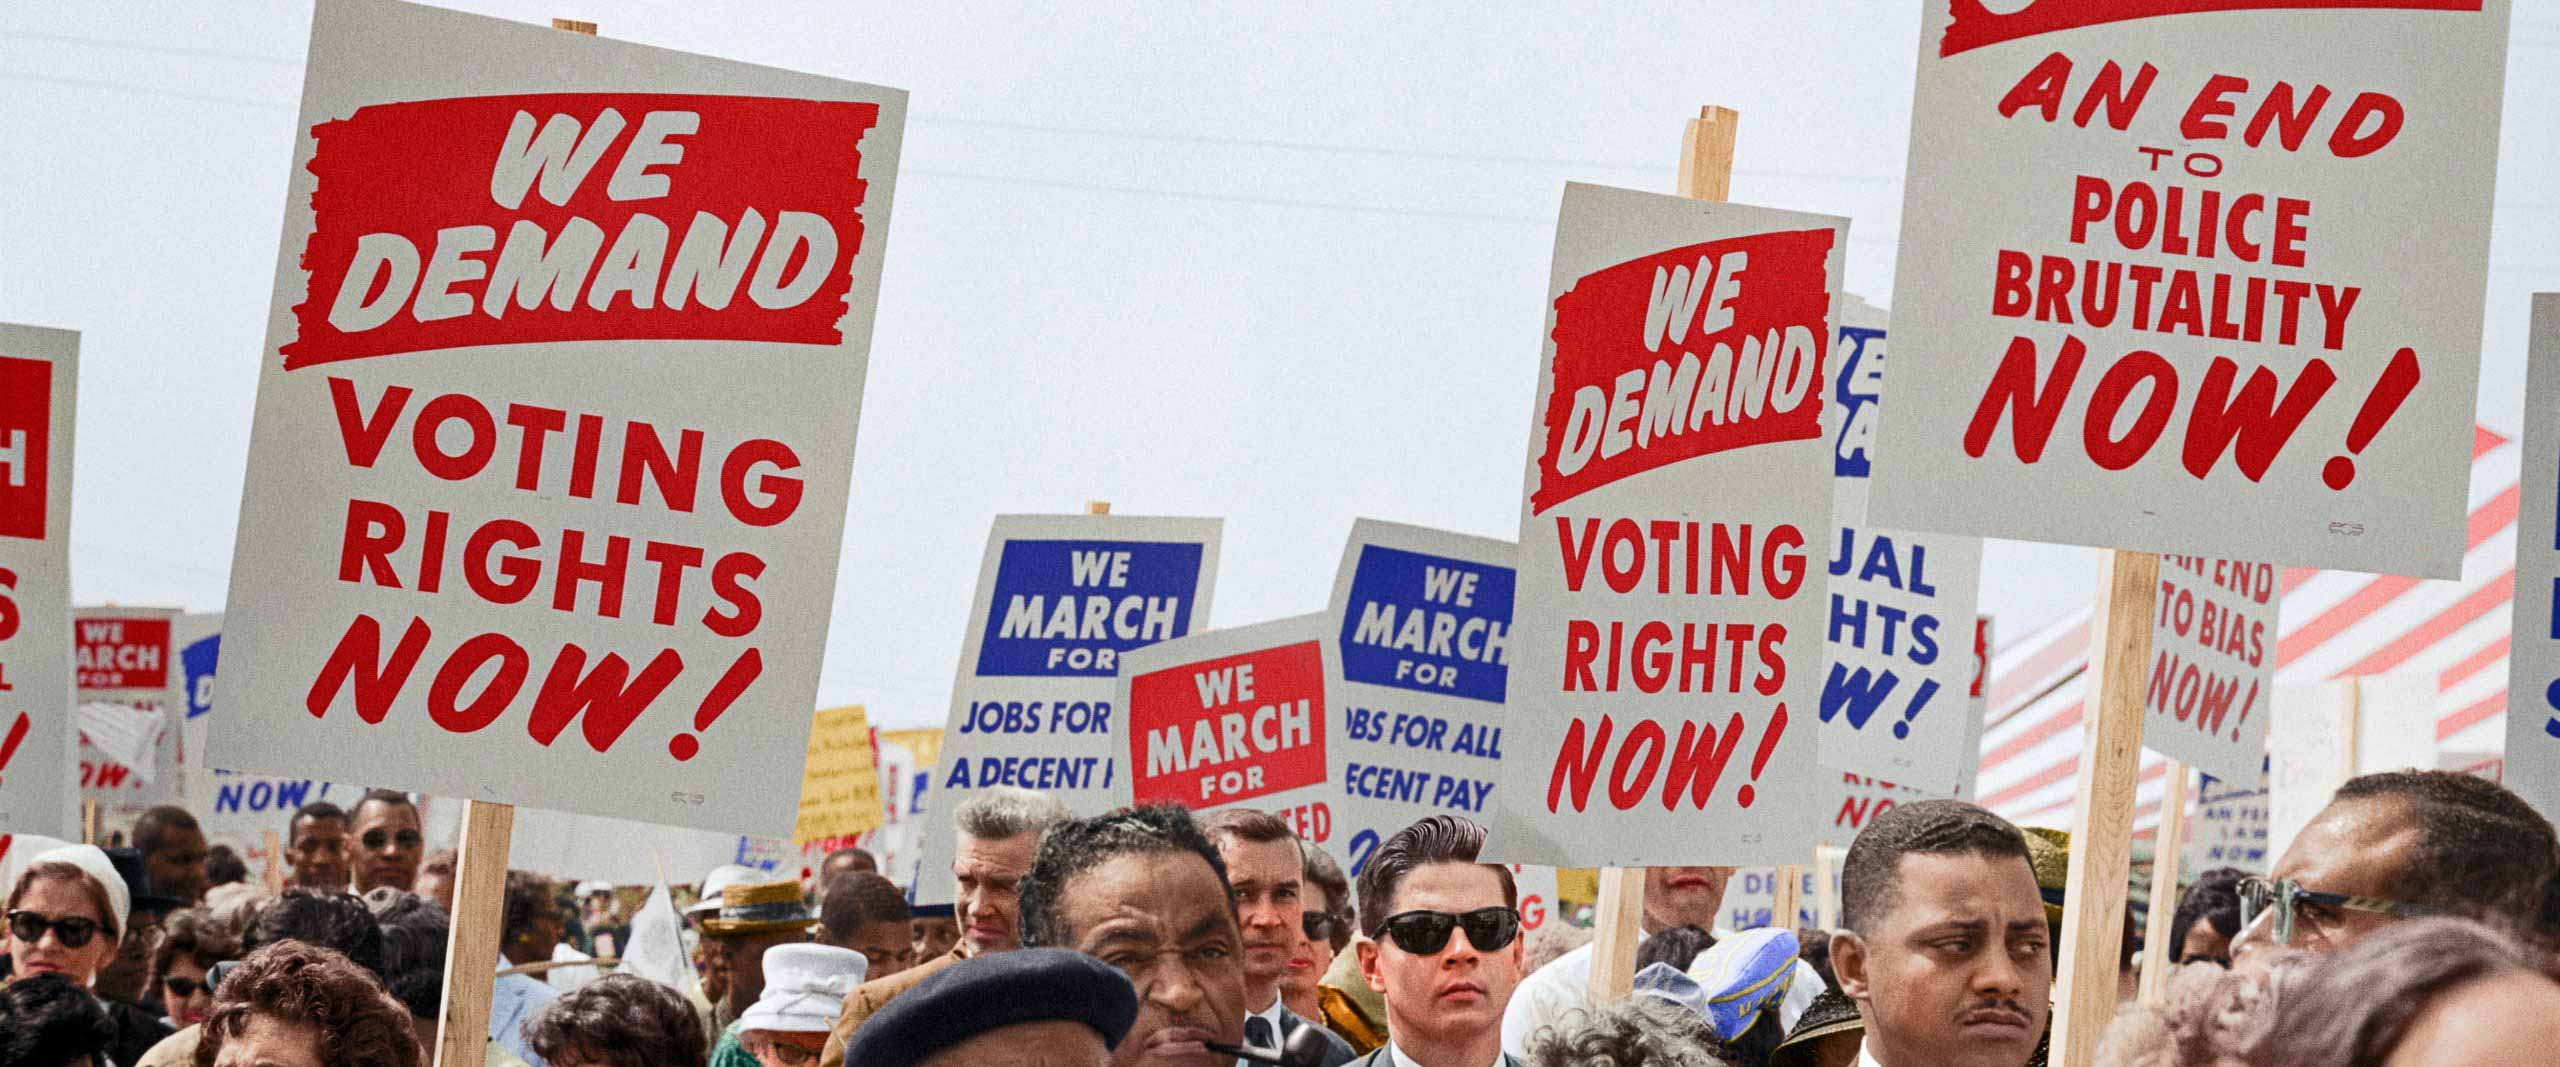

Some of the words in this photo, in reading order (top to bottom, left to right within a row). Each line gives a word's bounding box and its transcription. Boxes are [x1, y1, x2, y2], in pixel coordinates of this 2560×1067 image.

[1998, 51, 2159, 131] AN
[2179, 73, 2404, 158] END
[490, 107, 700, 210] WE
[2138, 146, 2223, 177] TO
[2070, 175, 2311, 268] POLICE
[328, 207, 838, 333] DEMAND
[1644, 251, 1747, 352] WE
[1992, 249, 2361, 350] BRUTALITY
[1556, 326, 1815, 477] DEMAND
[1963, 334, 2421, 491] NOW!
[327, 376, 804, 527] VOTING
[338, 499, 767, 638] RIGHTS
[1070, 551, 1131, 588] WE
[1423, 565, 1480, 608] WE
[1556, 517, 1807, 600] VOTING
[2214, 559, 2273, 606] END
[83, 623, 124, 644] WE
[1000, 595, 1178, 640] MARCH
[1352, 601, 1514, 667] MARCH
[2161, 579, 2194, 637] TO
[2198, 599, 2265, 668] BIAS
[306, 613, 763, 761] NOW!
[1047, 647, 1115, 670] FOR
[1194, 663, 1256, 709] WE
[1396, 659, 1457, 690] FOR
[1563, 621, 1788, 697] RIGHTS
[2146, 649, 2259, 743] NOW!
[960, 701, 1043, 734] JOBS
[1050, 701, 1111, 734] FOR
[1146, 698, 1311, 779] MARCH
[1390, 713, 1449, 751] FOR
[1451, 722, 1502, 760] ALL
[945, 757, 971, 789] A
[977, 757, 1099, 789] DECENT
[1201, 764, 1265, 800] FOR
[1433, 775, 1495, 812] PAY
[1547, 702, 1788, 815] NOW!
